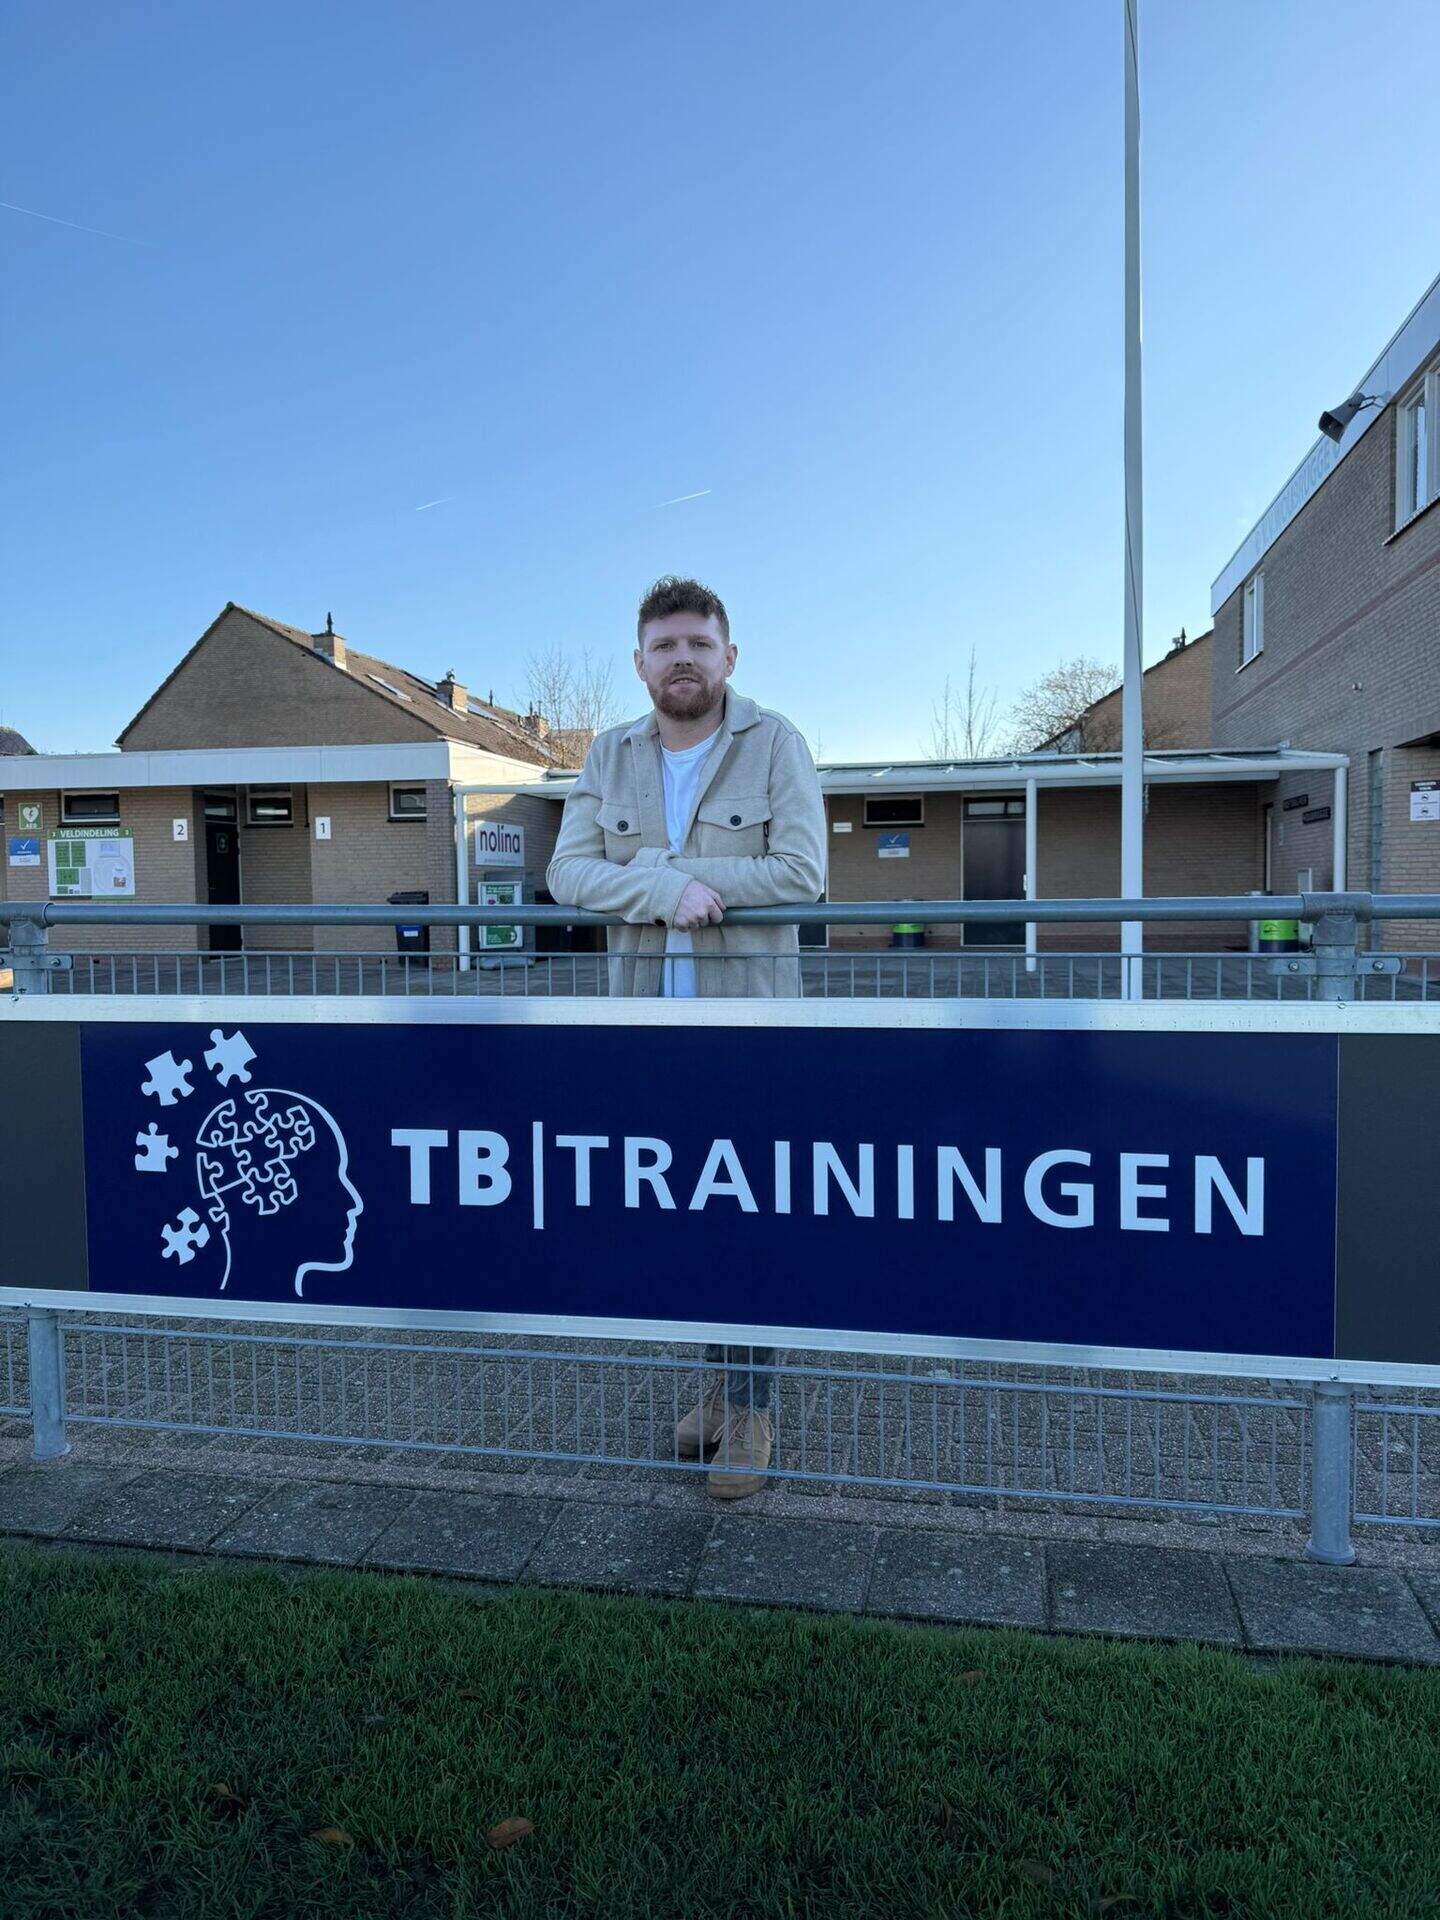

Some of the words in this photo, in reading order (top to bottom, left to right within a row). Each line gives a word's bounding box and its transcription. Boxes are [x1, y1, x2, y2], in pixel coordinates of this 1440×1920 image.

[60, 828, 119, 838] VELDINDELING
[178, 825, 185, 836] 2
[321, 823, 326, 833] 1
[480, 824, 520, 853] nolina
